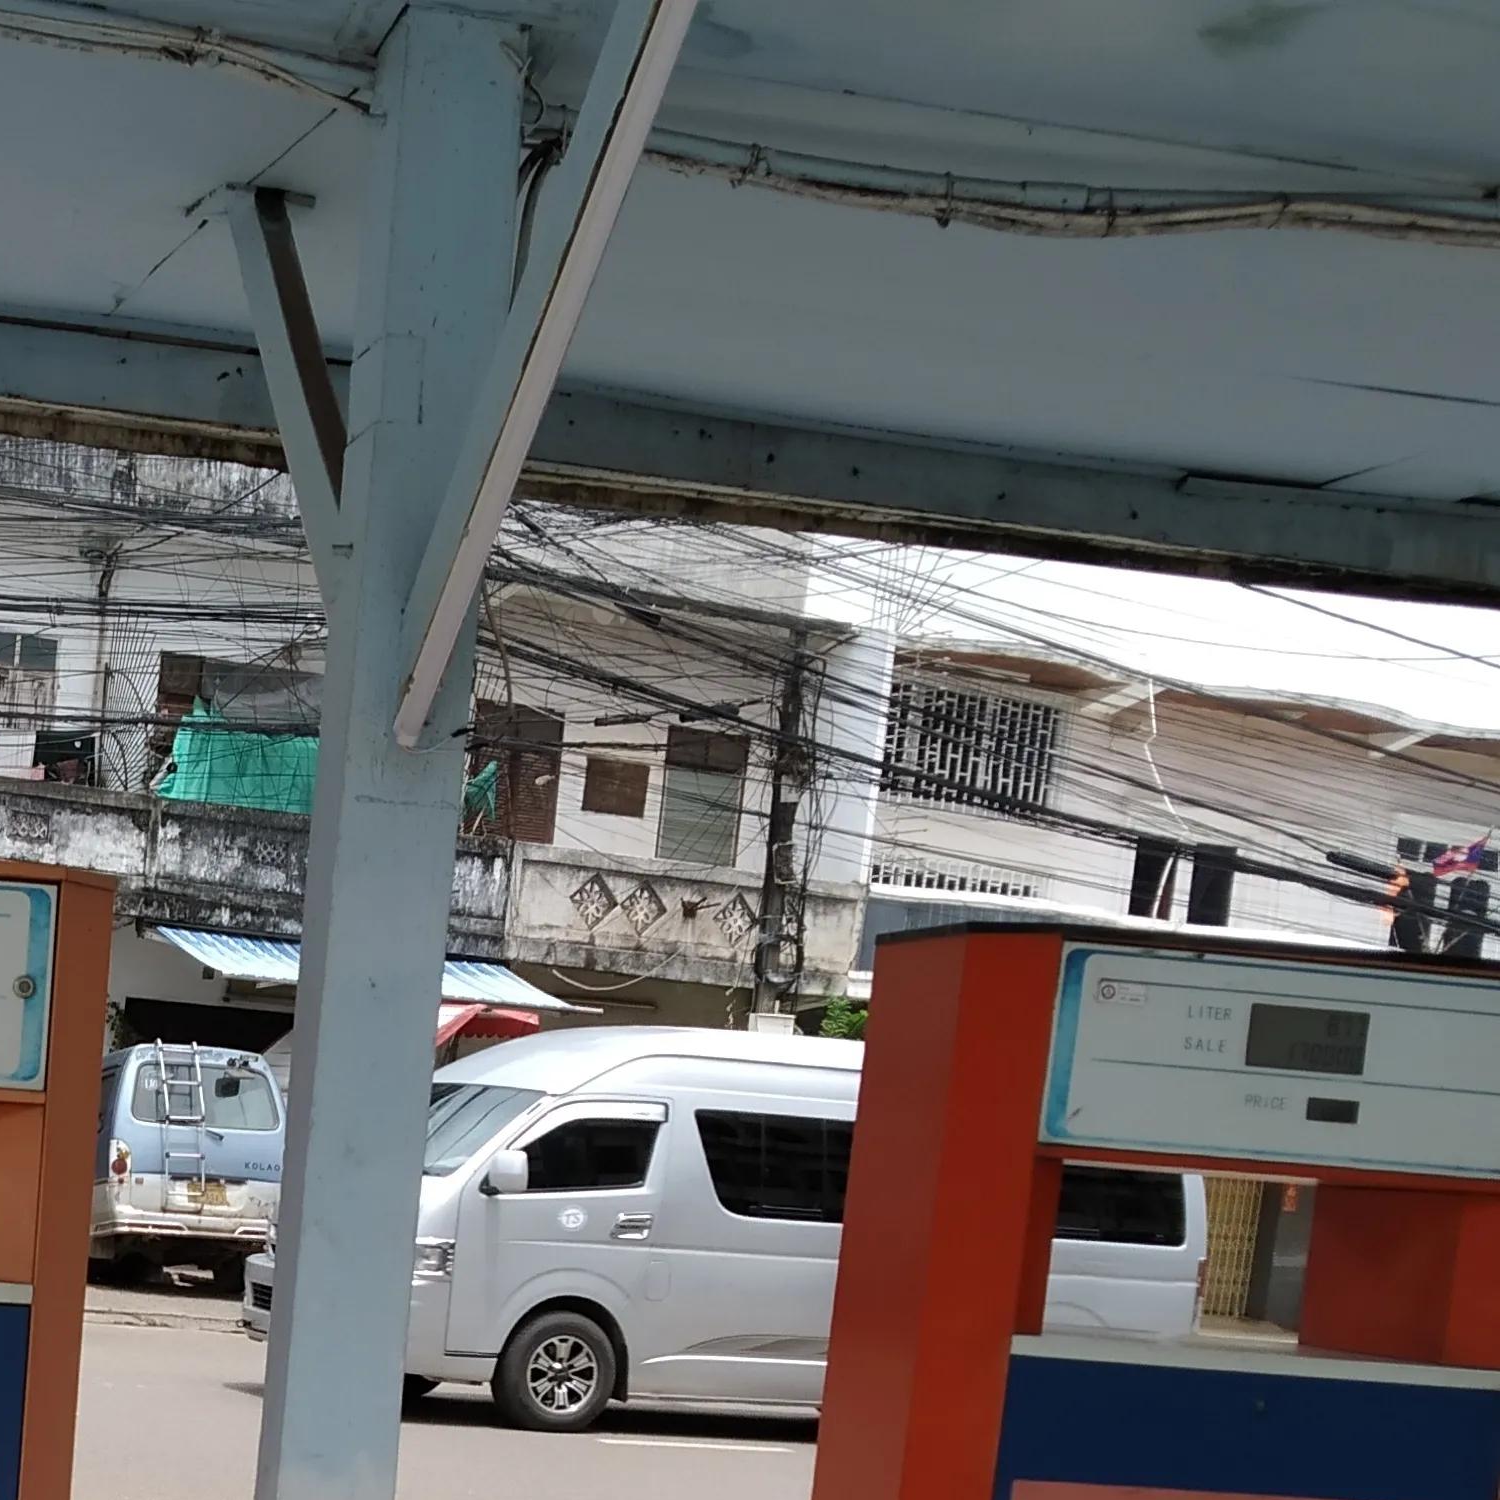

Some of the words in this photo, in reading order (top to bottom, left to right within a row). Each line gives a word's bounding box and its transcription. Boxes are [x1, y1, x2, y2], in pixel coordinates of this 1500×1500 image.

[1187, 1004, 1232, 1021] LITER
[1183, 1036, 1227, 1053] SALE
[1244, 1093, 1288, 1111] PRICE
[244, 1161, 281, 1172] KOLAO
